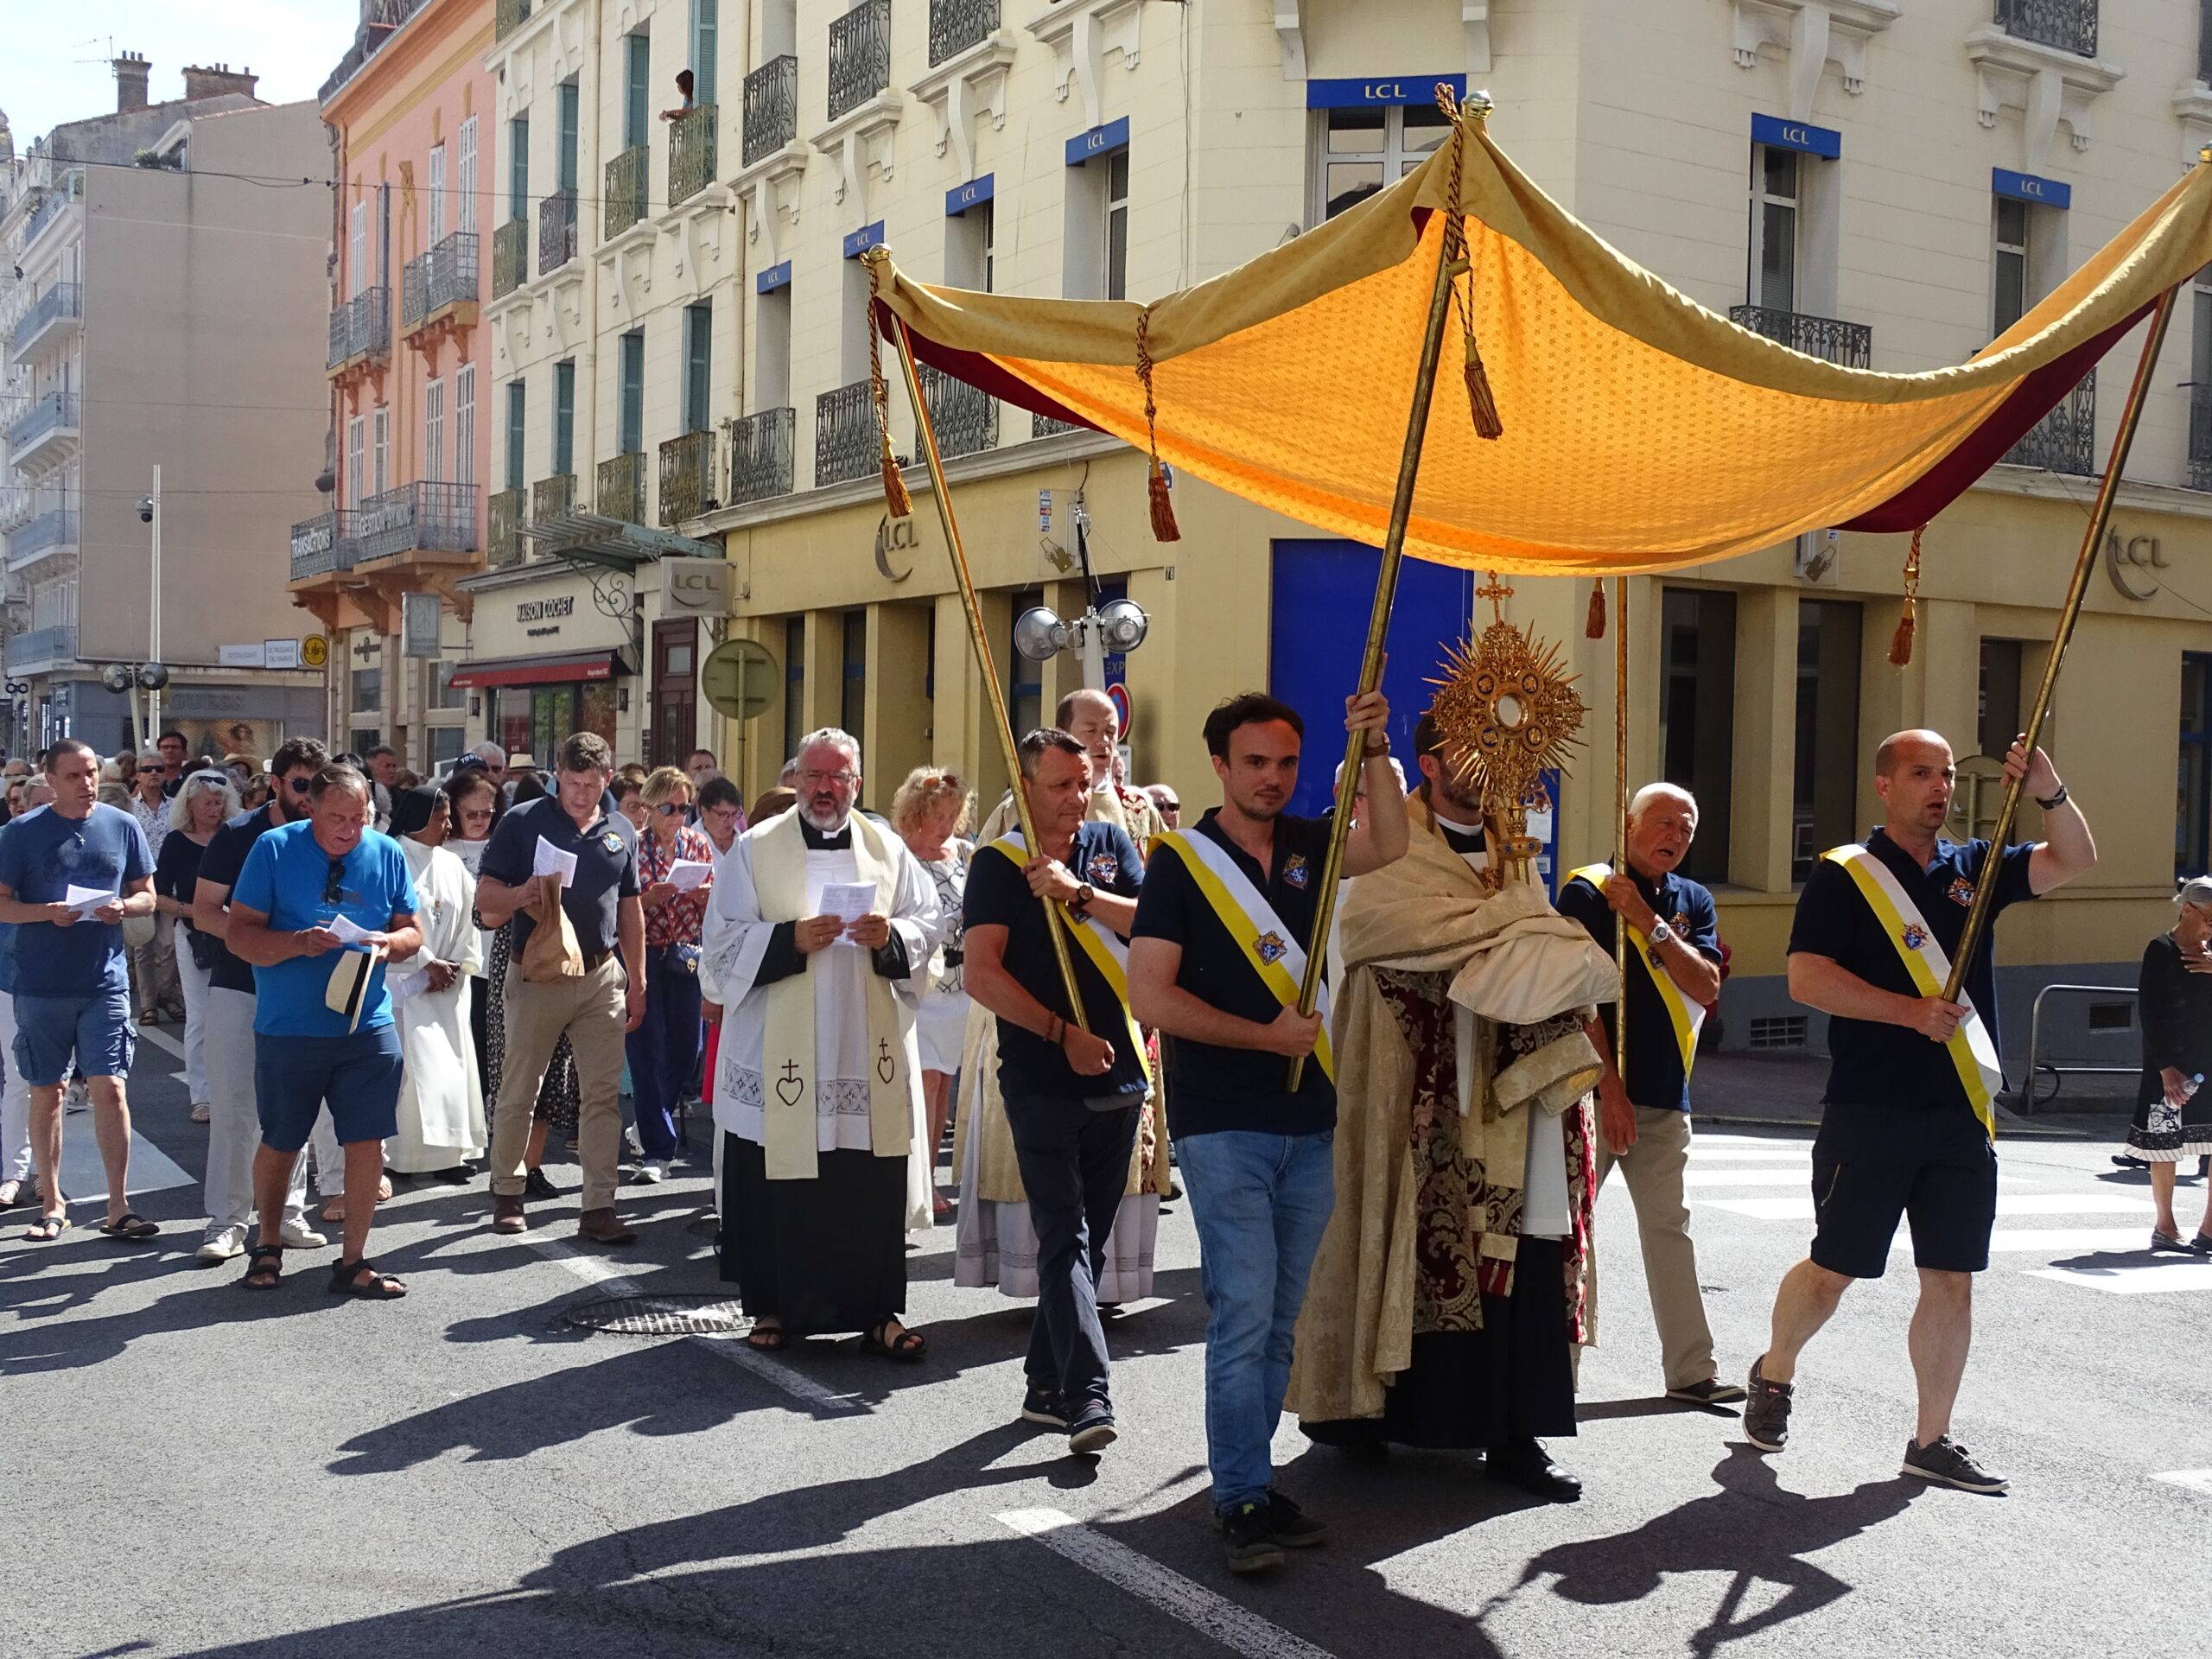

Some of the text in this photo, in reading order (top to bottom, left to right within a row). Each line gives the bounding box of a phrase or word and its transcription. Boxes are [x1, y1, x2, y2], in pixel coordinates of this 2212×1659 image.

[1365, 85, 1407, 99] LCL
[1087, 133, 1105, 149] LCL
[1783, 127, 1809, 145] LCL
[963, 188, 976, 202] LCL
[2021, 180, 2044, 196] LCL
[857, 233, 869, 246] LCL
[768, 271, 779, 283] LCL
[881, 520, 919, 552] LCL
[2113, 535, 2171, 569] LCL
[1164, 567, 1175, 581] 78
[673, 574, 720, 591] LCL
[517, 595, 575, 622] MAISON COCHET
[172, 693, 245, 711] GUESS
